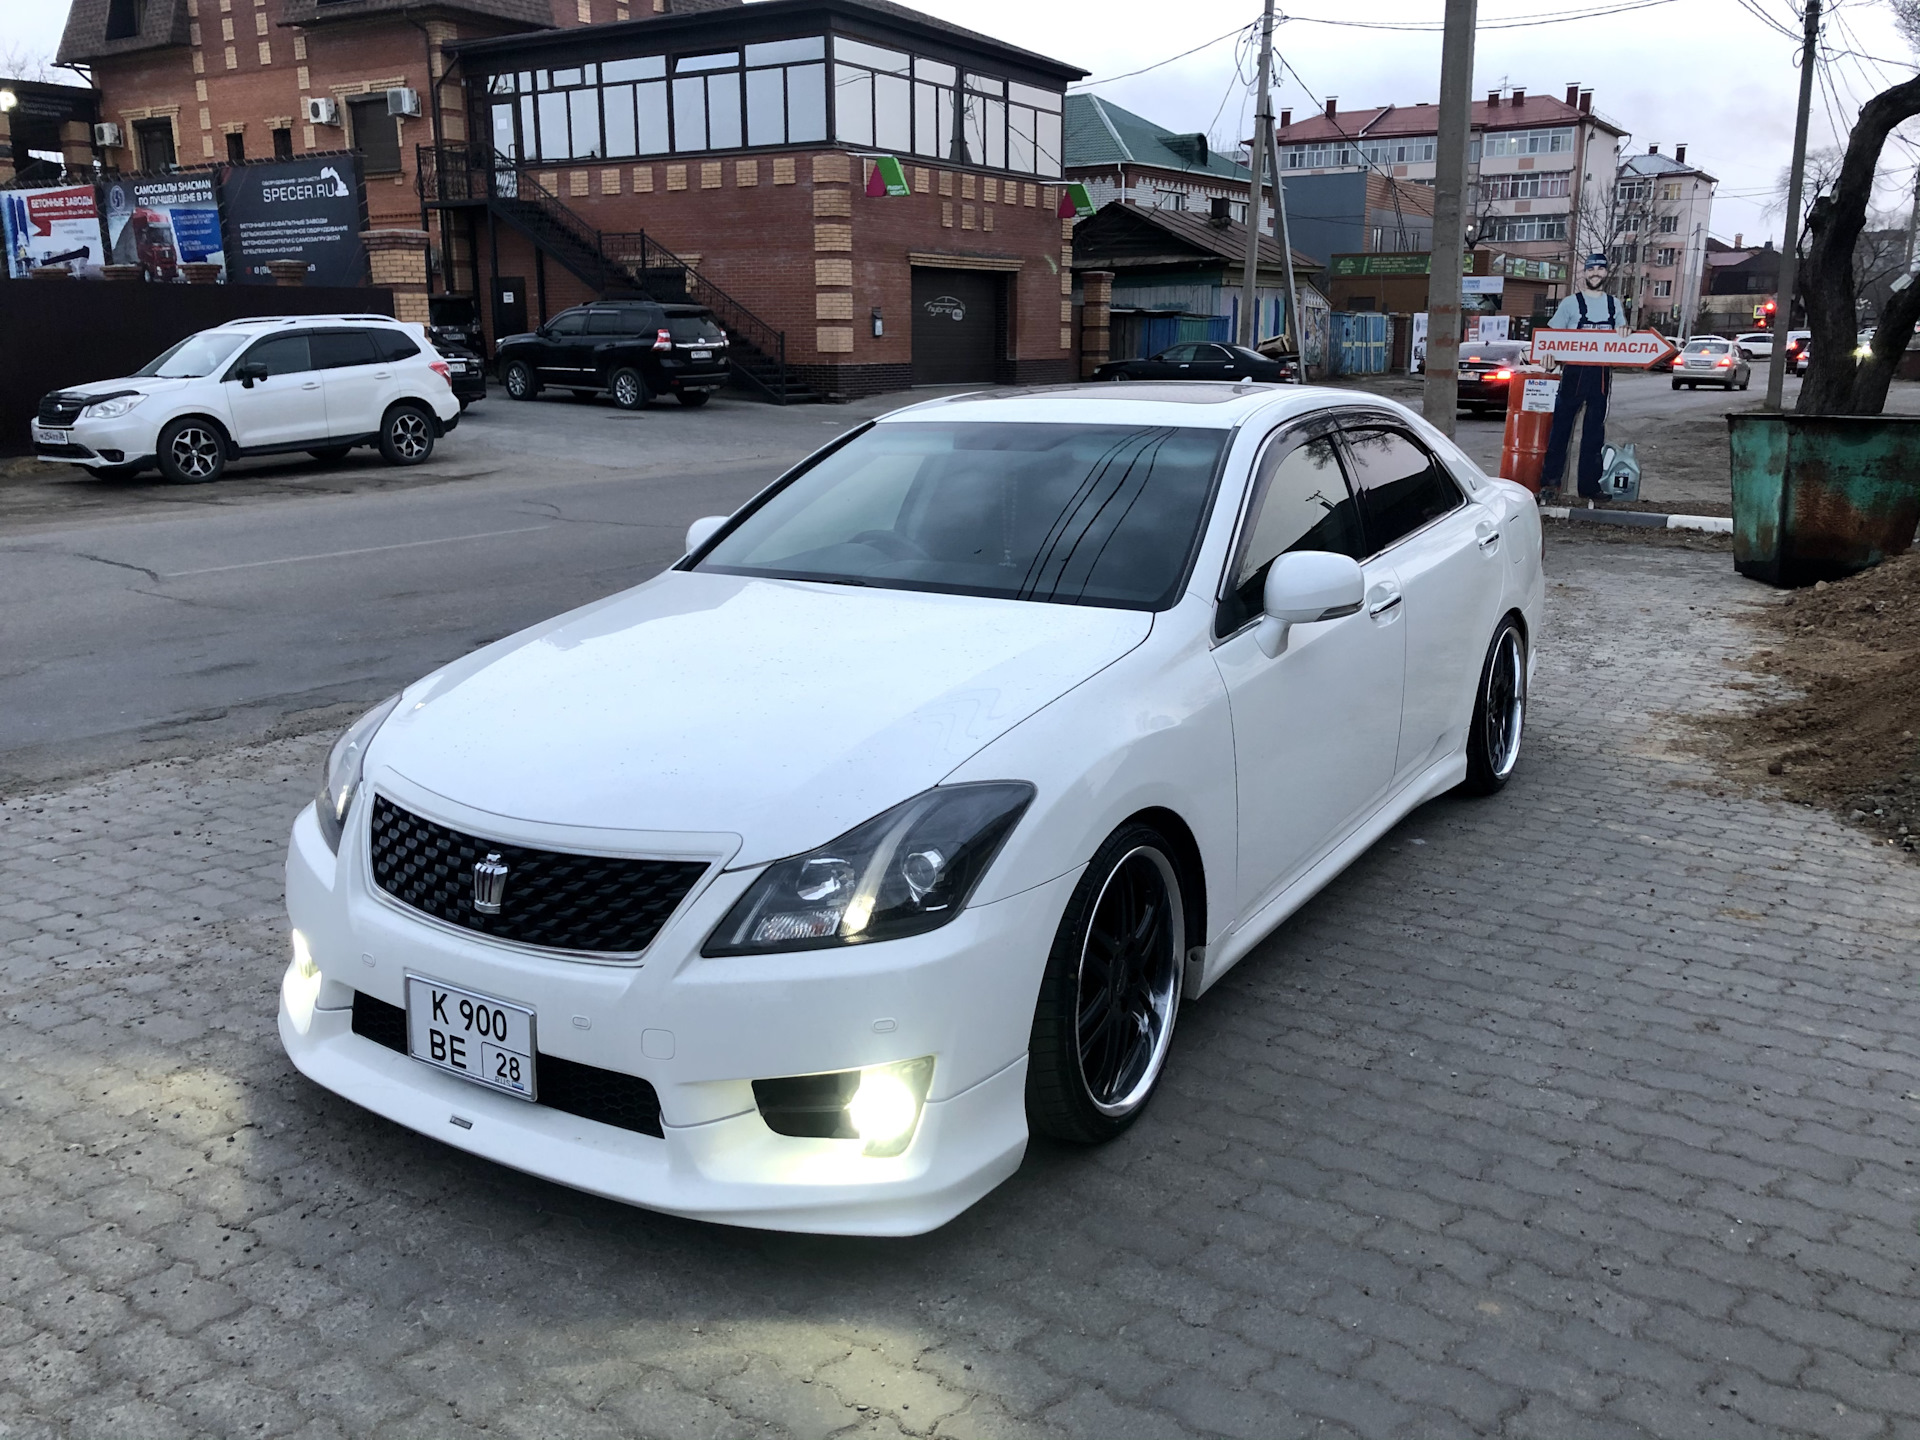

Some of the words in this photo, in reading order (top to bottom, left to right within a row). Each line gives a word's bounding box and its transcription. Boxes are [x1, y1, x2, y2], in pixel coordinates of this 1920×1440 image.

[134, 183, 177, 195] САМОСВАЛЫ
[179, 180, 211, 191] SHACMAN
[263, 183, 335, 202] SPECER.RU
[31, 198, 65, 209] БЕТОННЫЕ
[65, 196, 93, 207] ЗАВОДЫ
[138, 197, 148, 206] ПО
[149, 193, 177, 205] ЛУЧШЕЙ
[178, 192, 196, 203] ЦЕНЕ
[196, 193, 202, 201] В
[203, 191, 213, 201] РФ
[1538, 340, 1598, 352] ЗАМЕНА
[1603, 342, 1659, 353] МАСЛА
[1618, 477, 1624, 487] 1
[459, 999, 507, 1042] 900
[495, 1053, 521, 1082] 28
